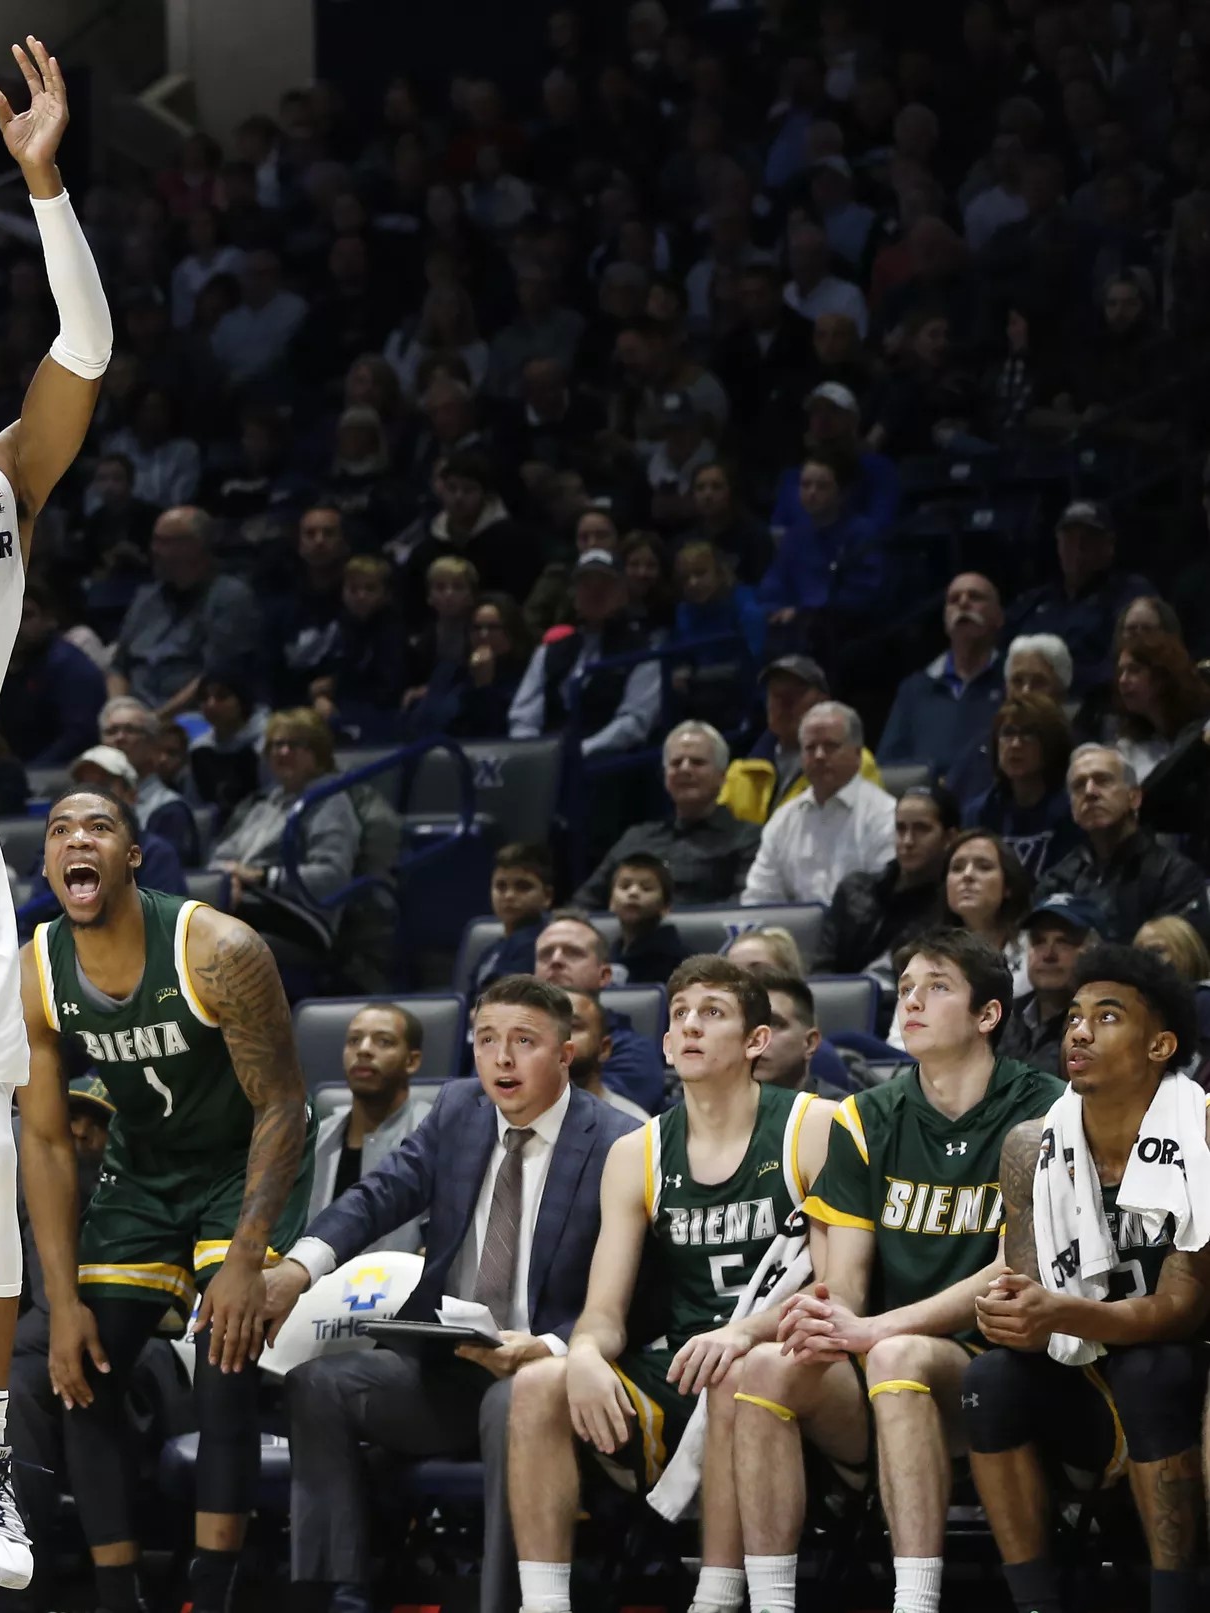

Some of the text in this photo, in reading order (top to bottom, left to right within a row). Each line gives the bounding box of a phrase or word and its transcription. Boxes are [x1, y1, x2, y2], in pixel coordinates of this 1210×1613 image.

[75, 1021, 190, 1062] SIENA
[143, 1066, 174, 1118] 1
[664, 1197, 778, 1246] SIENA
